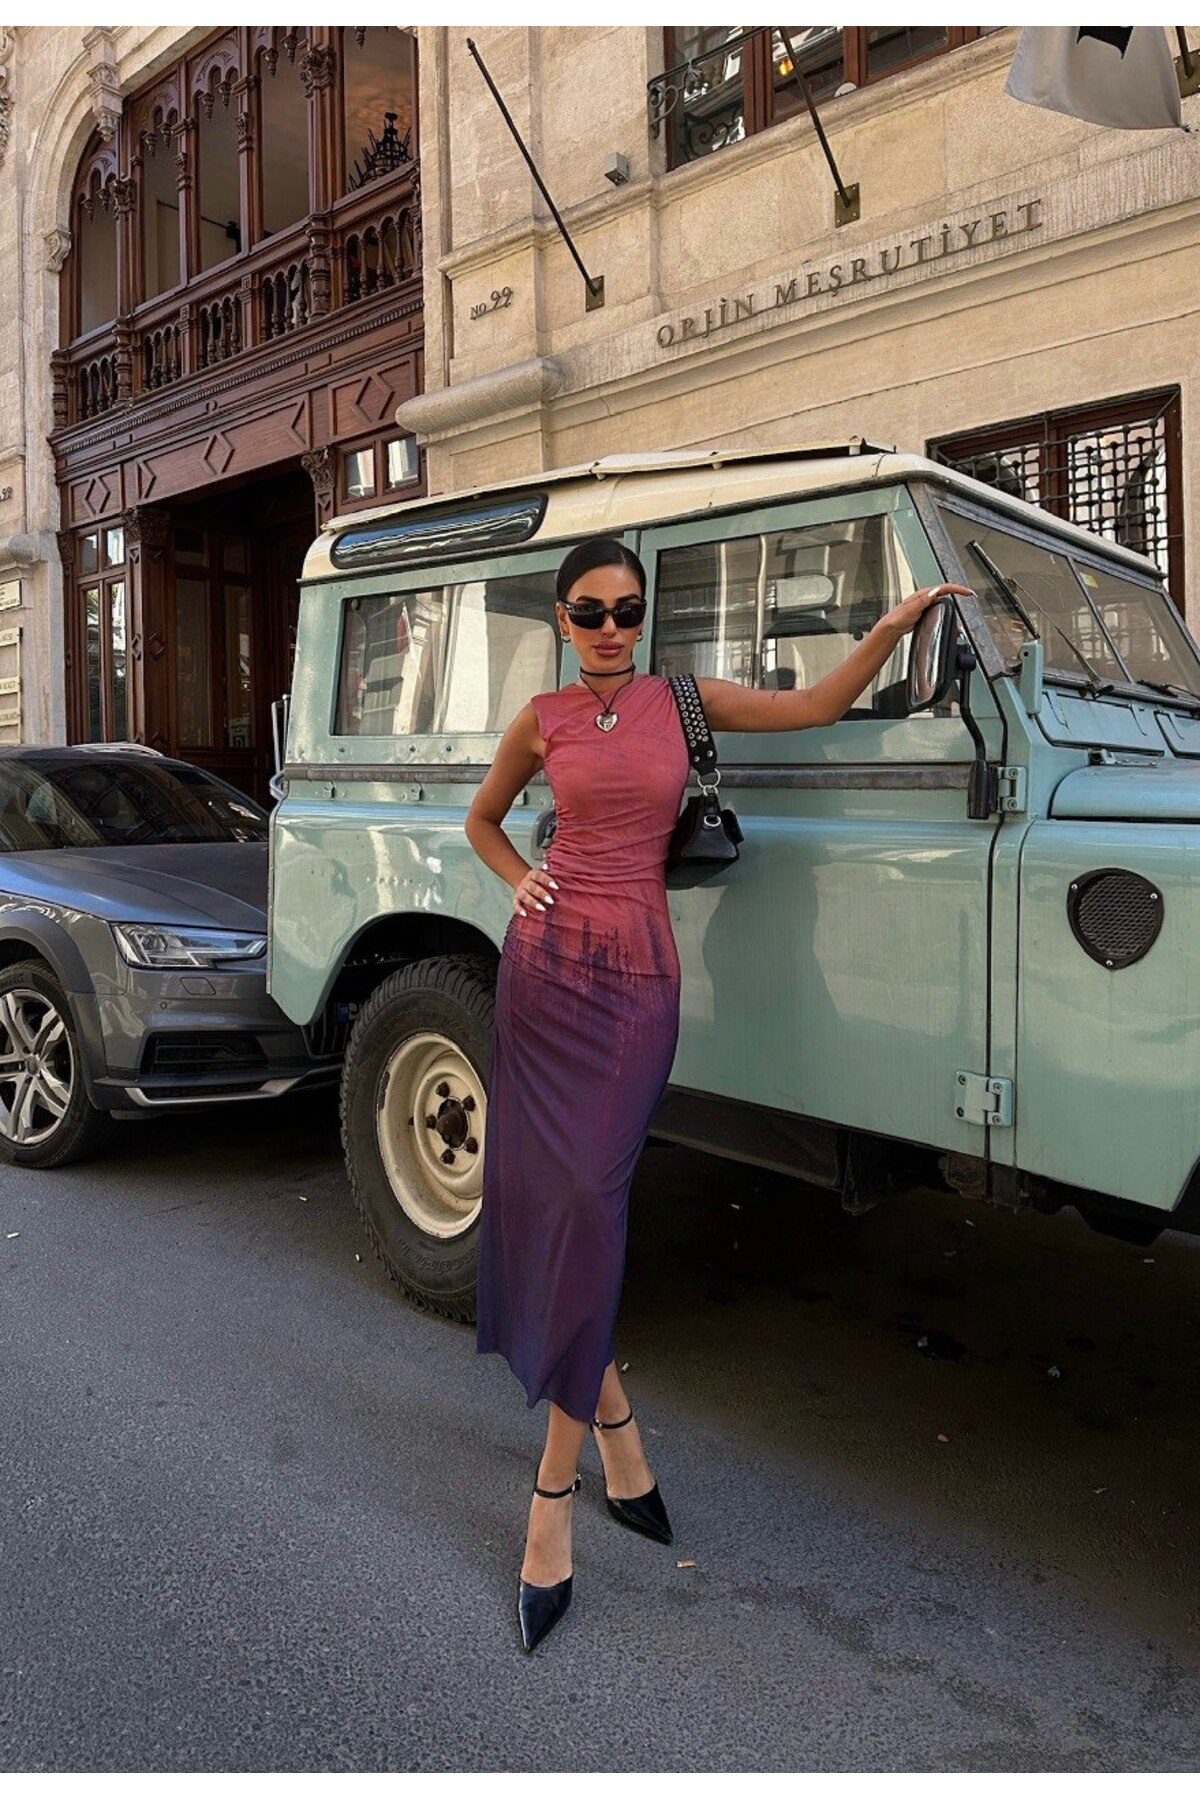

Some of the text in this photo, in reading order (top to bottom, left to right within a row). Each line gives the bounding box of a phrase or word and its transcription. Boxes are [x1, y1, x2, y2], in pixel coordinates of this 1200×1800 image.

[490, 286, 514, 310] 99
[656, 199, 1044, 348] ORJİN MEŞRUTİYET
